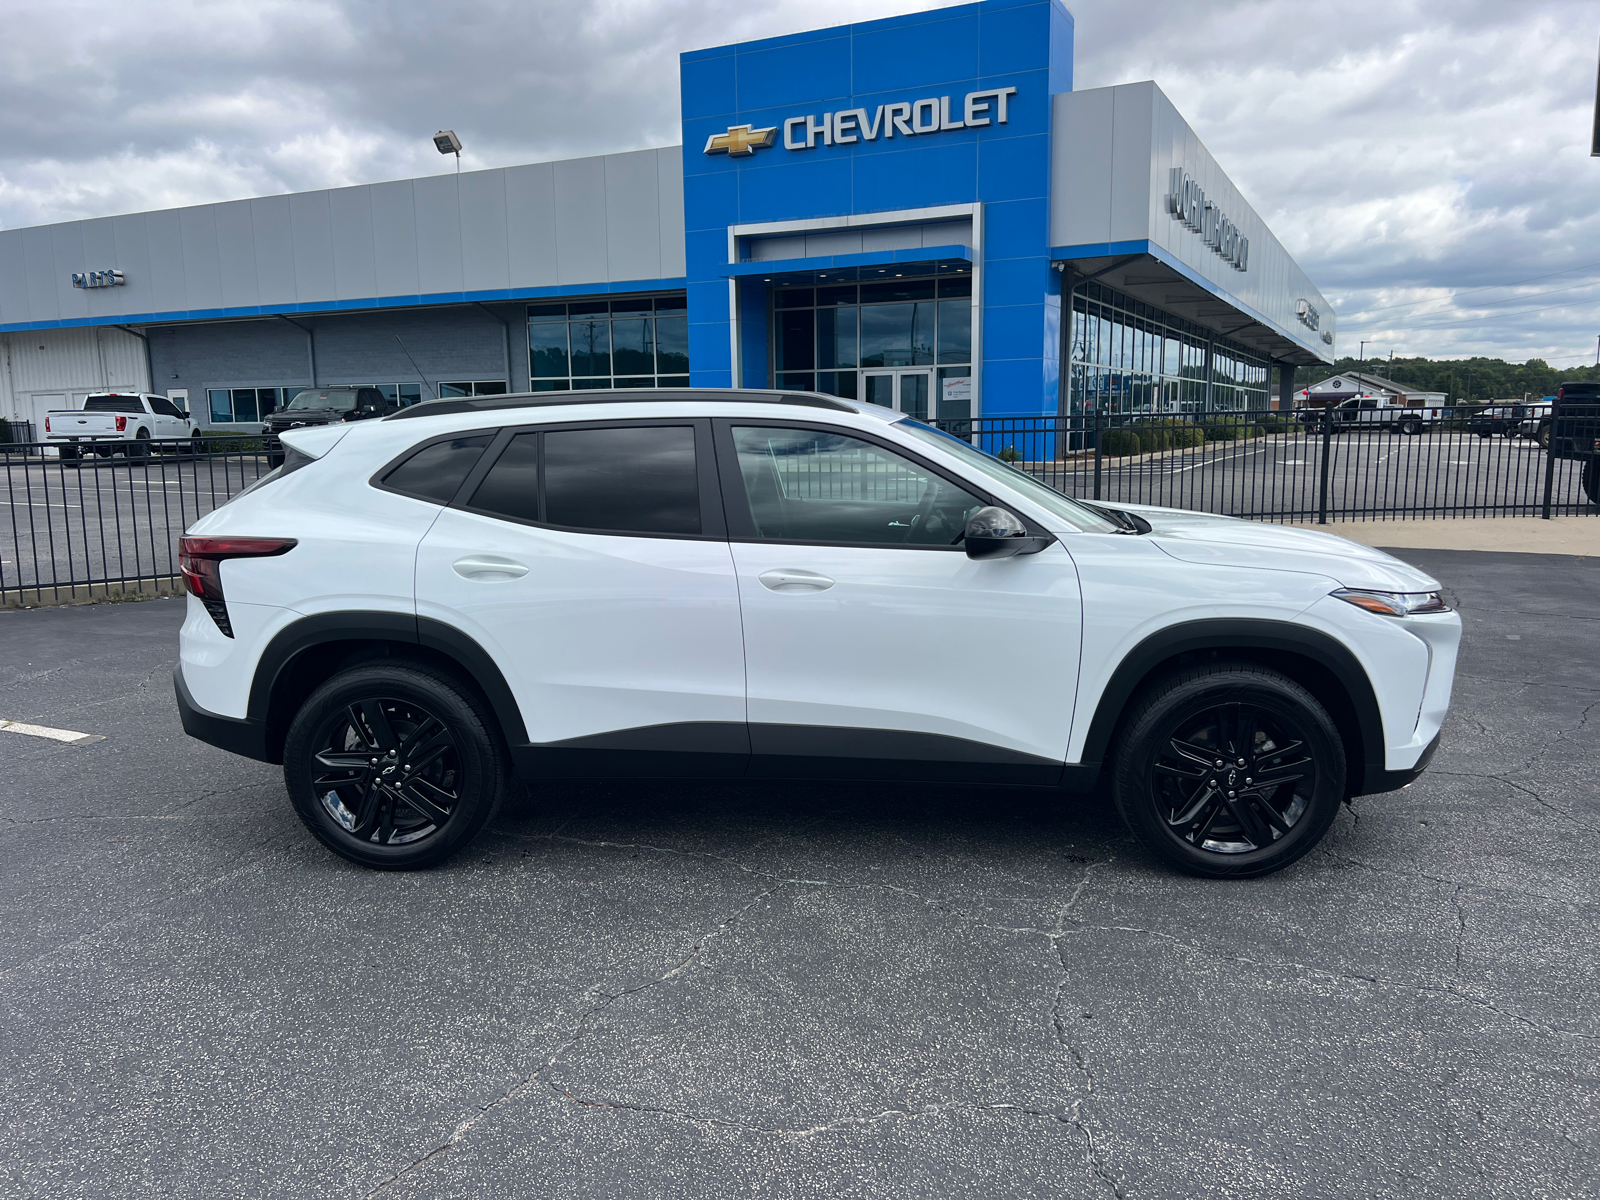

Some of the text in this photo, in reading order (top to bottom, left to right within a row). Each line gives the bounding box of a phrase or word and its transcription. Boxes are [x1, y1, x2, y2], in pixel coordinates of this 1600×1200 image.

[784, 86, 1017, 150] CHEVROLET
[1174, 167, 1205, 233] JOHN
[72, 269, 117, 288] PARTS
